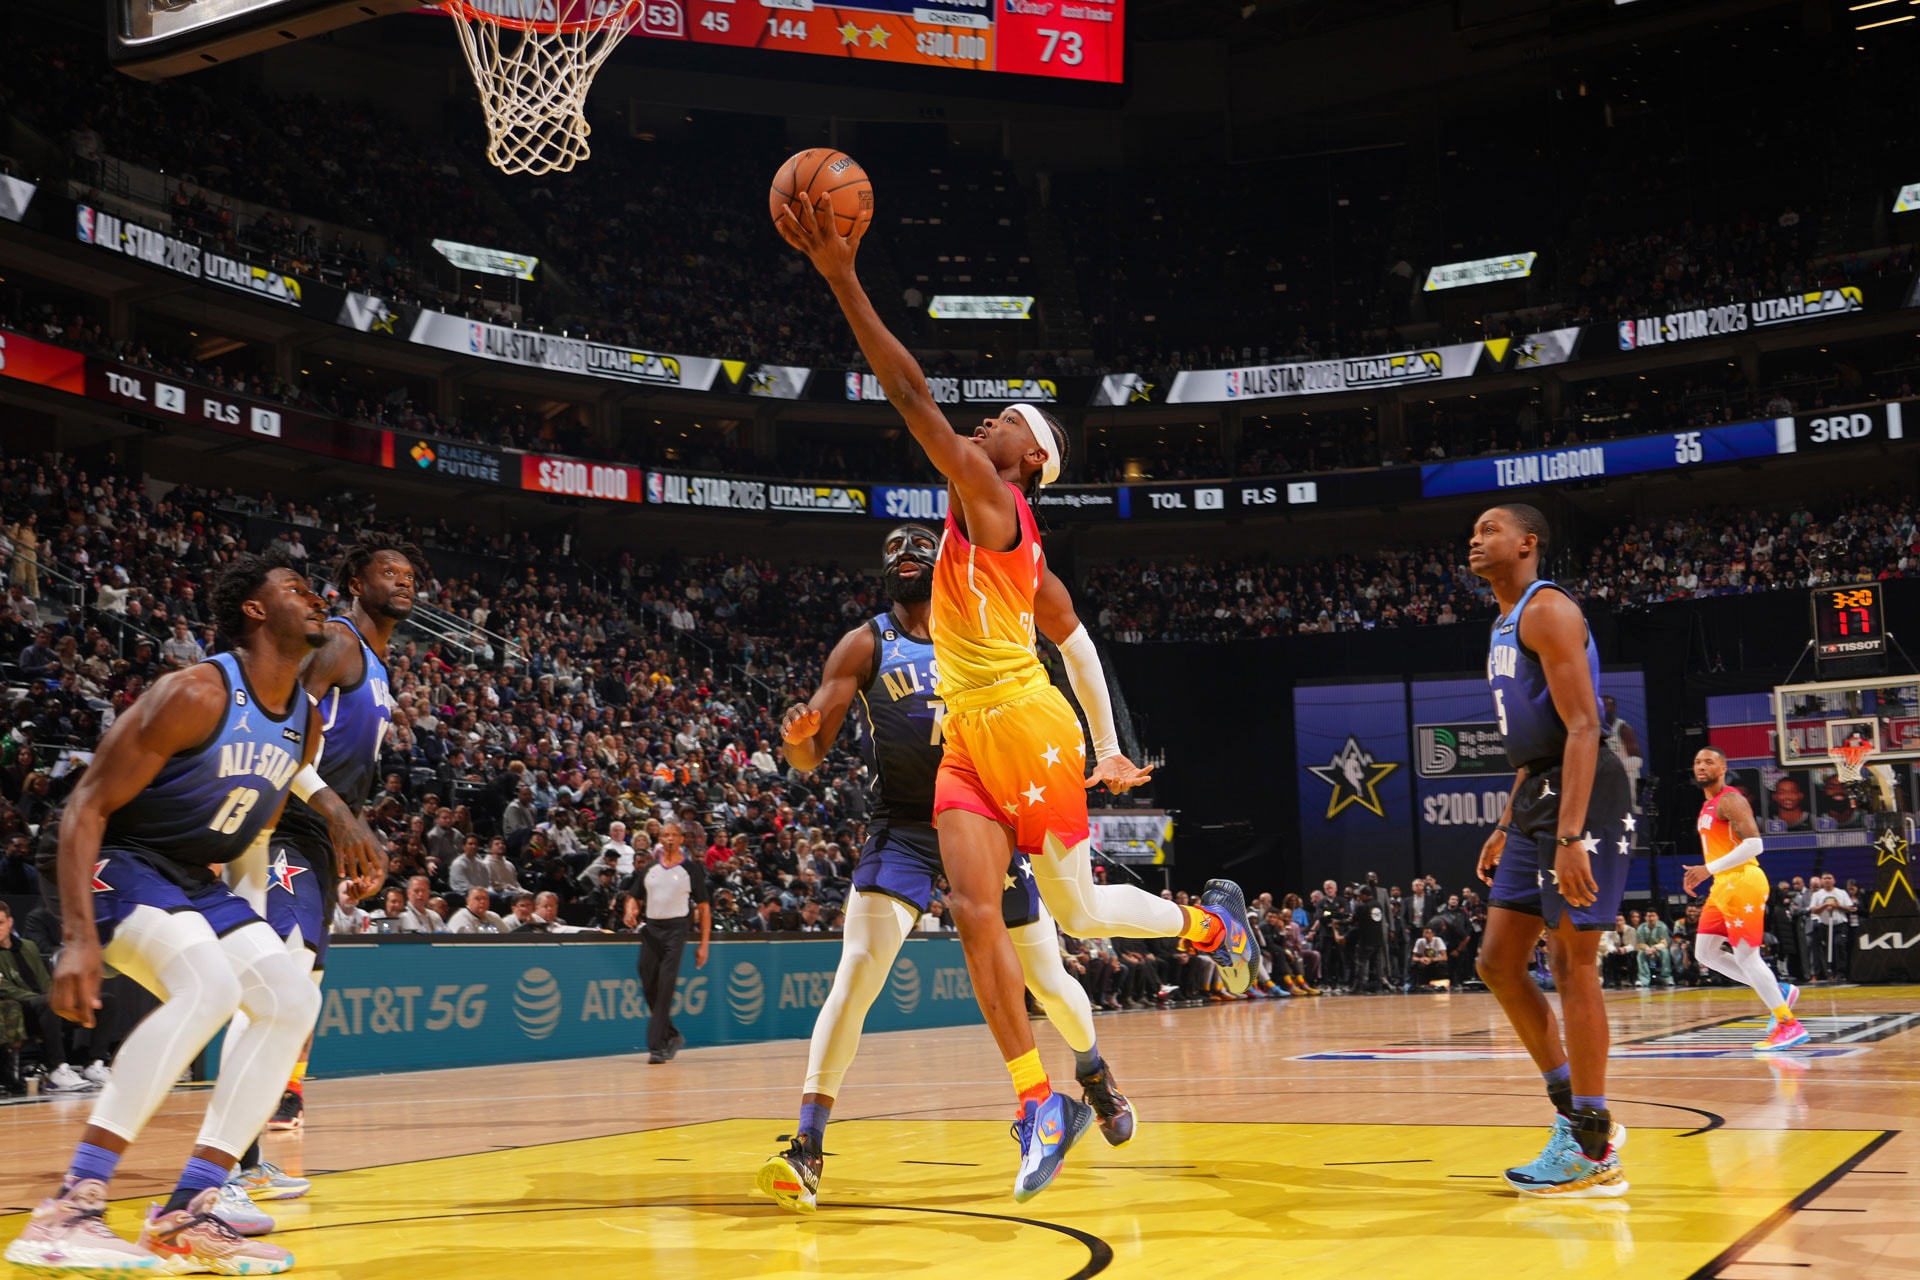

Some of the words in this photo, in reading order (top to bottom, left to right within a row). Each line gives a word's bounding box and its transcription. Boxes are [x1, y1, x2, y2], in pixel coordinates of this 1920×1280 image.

[648, 6, 676, 26] 53
[700, 11, 730, 32] 45
[767, 18, 807, 40] 144
[928, 11, 976, 25] CHARITY
[1036, 28, 1083, 65] 73
[204, 252, 252, 287] UTAH
[1752, 296, 1805, 322] UTAH
[588, 346, 632, 373] UTAH
[1345, 358, 1393, 383] UTAH
[105, 371, 148, 402] TOL
[203, 399, 241, 426] FLS
[963, 379, 1009, 399] UTAH
[1809, 413, 1872, 443] 3RD
[437, 443, 481, 465] RAISE
[482, 454, 501, 467] the
[1494, 454, 1539, 488] TEAM
[1674, 431, 1704, 465] 35
[437, 458, 500, 482] FUTURE
[539, 460, 628, 501] $300,000
[770, 485, 817, 508] UTAH
[1149, 491, 1187, 510] TOL
[1241, 487, 1277, 506] FLS
[1839, 607, 1870, 635] 17
[1839, 640, 1881, 652] TISSOT
[235, 691, 247, 706] 6
[926, 700, 947, 746] 7
[1459, 732, 1476, 745] Big
[1459, 745, 1477, 759] Big
[218, 741, 299, 791] ALL-STAR
[208, 786, 260, 835] 13
[1424, 791, 1510, 827] $200,00
[931, 967, 976, 1000] AT&
[316, 986, 424, 1037] AT&T
[425, 984, 489, 1031] 5G
[581, 978, 653, 1022] AT&
